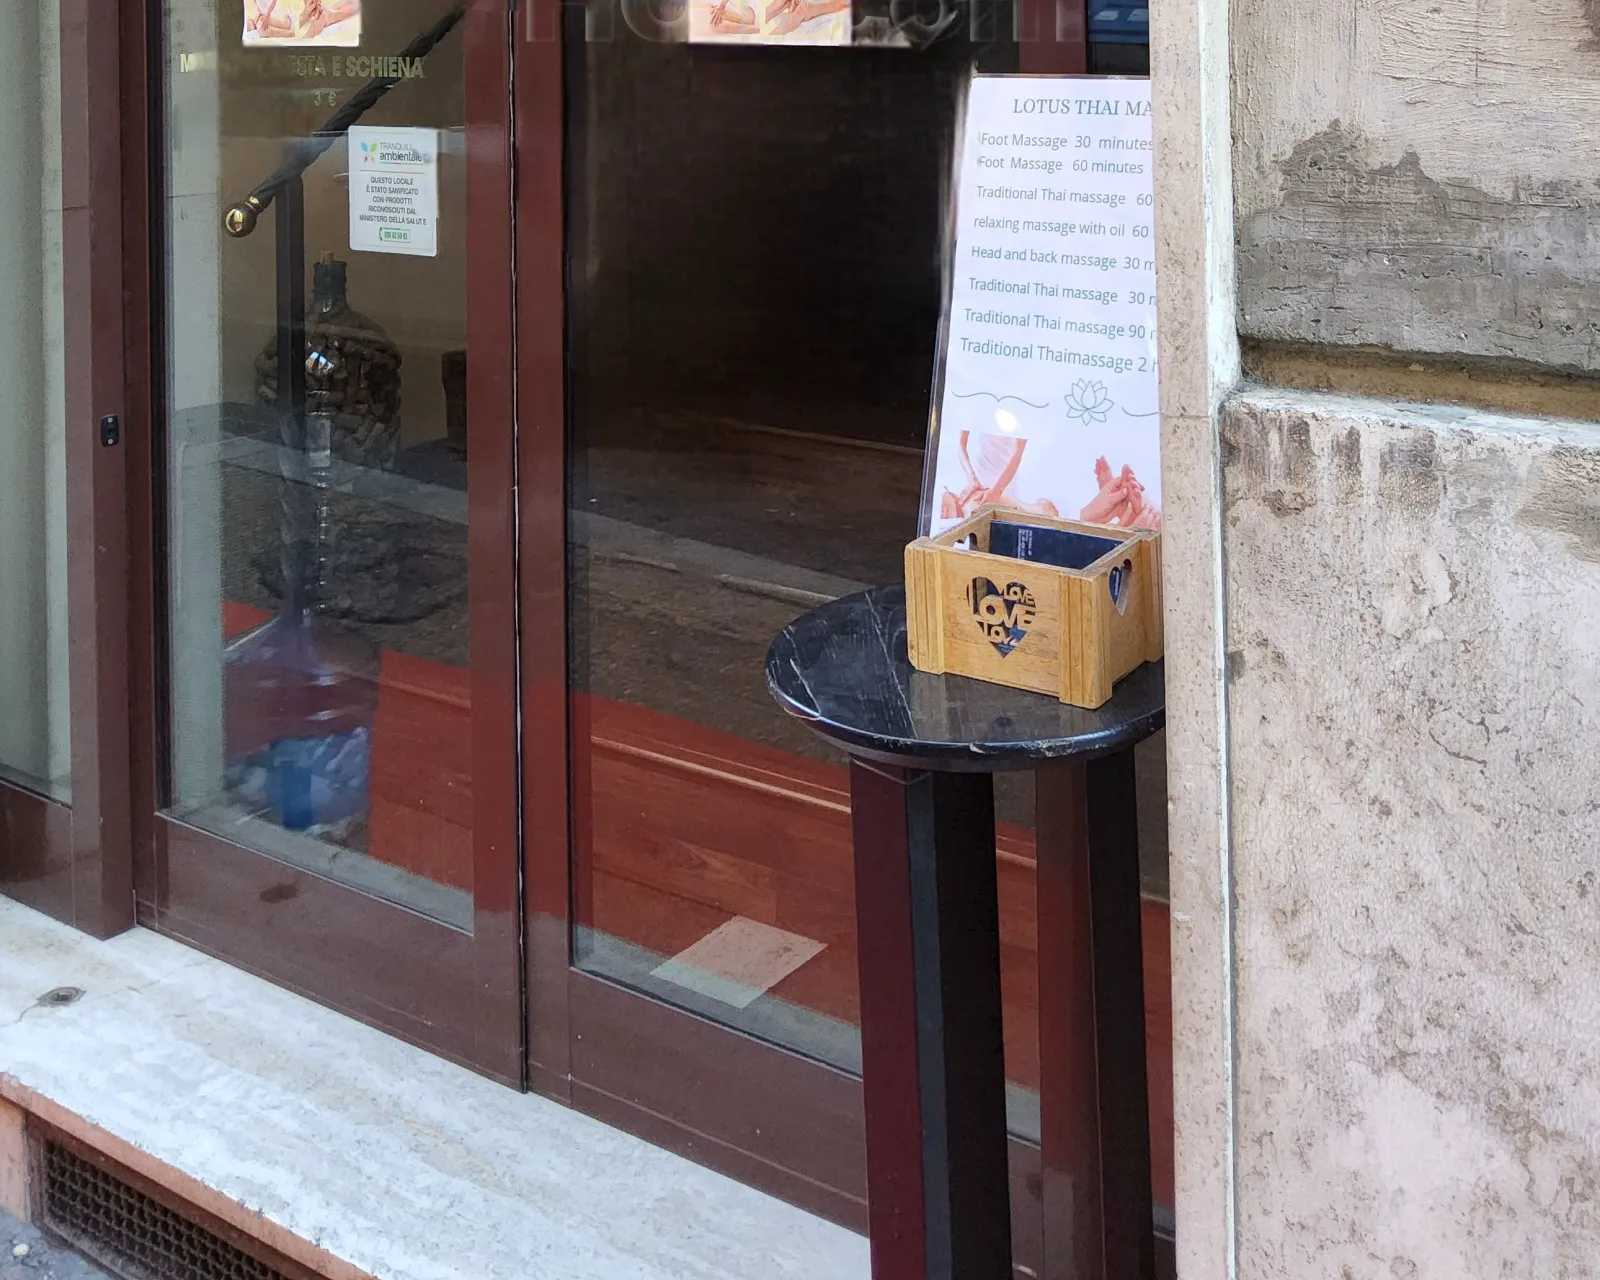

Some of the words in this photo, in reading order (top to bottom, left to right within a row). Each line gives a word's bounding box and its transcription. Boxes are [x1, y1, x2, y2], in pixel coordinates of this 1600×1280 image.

[1014, 99, 1069, 113] LOTUS
[1076, 100, 1119, 115] THAI
[982, 133, 1008, 145] Foot
[1012, 134, 1067, 150] Massage
[1075, 136, 1091, 148] 30
[979, 156, 1004, 168] Foot
[1011, 157, 1062, 174] Massage
[1073, 160, 1087, 171] 60
[1092, 161, 1143, 174] minutes
[371, 186, 387, 194] STATO
[388, 187, 418, 195] SANIFICATO
[977, 186, 1037, 199] Traditional
[1041, 188, 1065, 201] Thai
[1070, 192, 1125, 207] massage
[1137, 193, 1152, 206] 60
[368, 206, 405, 214] RICONOSCIUTI
[386, 197, 412, 205] PRODOTTI
[974, 217, 1019, 233] relaxing
[1023, 220, 1076, 236] massage
[1079, 222, 1106, 235] with
[1110, 224, 1124, 236] oil
[1133, 226, 1148, 237] 60
[972, 246, 1001, 259] Head
[1005, 249, 1026, 261] and
[1031, 250, 1057, 263] back
[1062, 254, 1117, 271] massage
[1124, 257, 1139, 269] 30
[969, 278, 1030, 294] Traditional
[1033, 283, 1058, 296] Thai
[1062, 287, 1117, 305] massage
[1129, 292, 1144, 304] 30
[965, 308, 1030, 327] Traditional
[1034, 315, 1060, 330] Thai
[1065, 321, 1124, 339] massage
[1129, 325, 1145, 338] 90
[961, 338, 1032, 358] Traditional
[1138, 357, 1147, 372] 2
